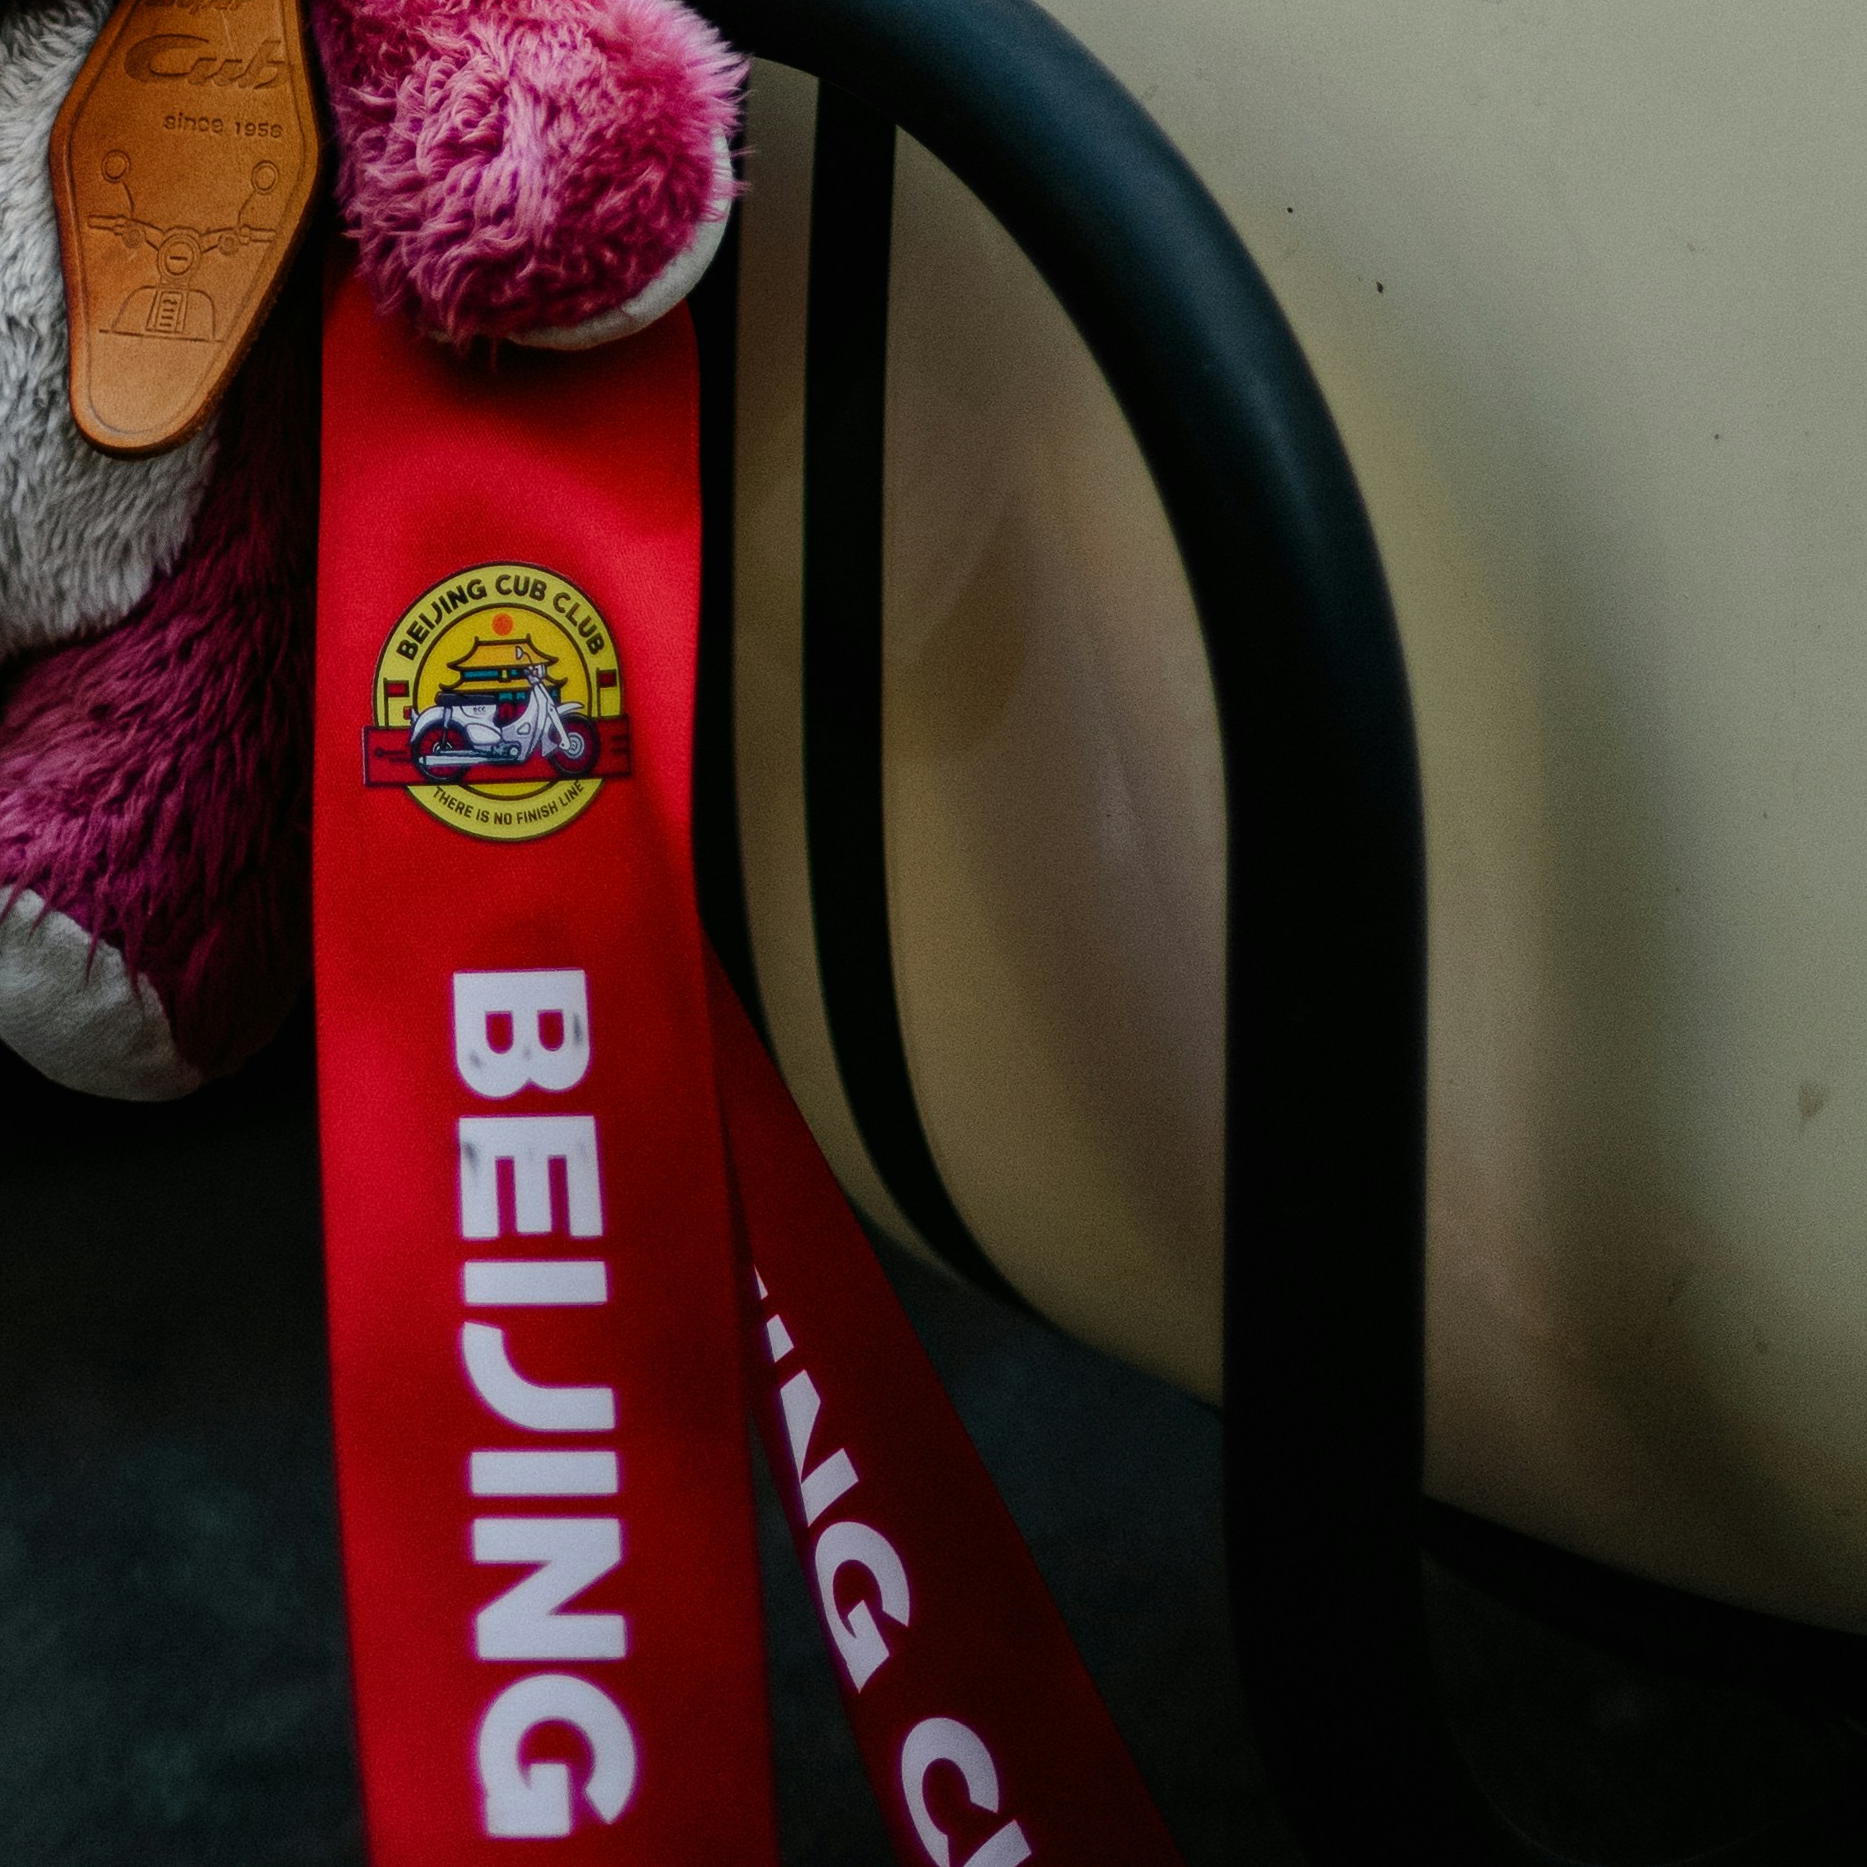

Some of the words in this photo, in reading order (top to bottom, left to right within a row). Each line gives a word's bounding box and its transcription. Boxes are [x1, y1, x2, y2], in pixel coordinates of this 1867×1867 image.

[124, 33, 285, 90] Cub
[164, 113, 224, 134] since
[396, 578, 488, 661] BEIJING
[495, 574, 548, 602] CUB
[553, 592, 605, 656] CLUB
[433, 785, 474, 819] THERE
[476, 808, 490, 824] IS
[494, 812, 513, 825] NO
[517, 801, 559, 825] FINISH
[559, 779, 585, 808] LINE
[452, 969, 637, 1839] BEIJING
